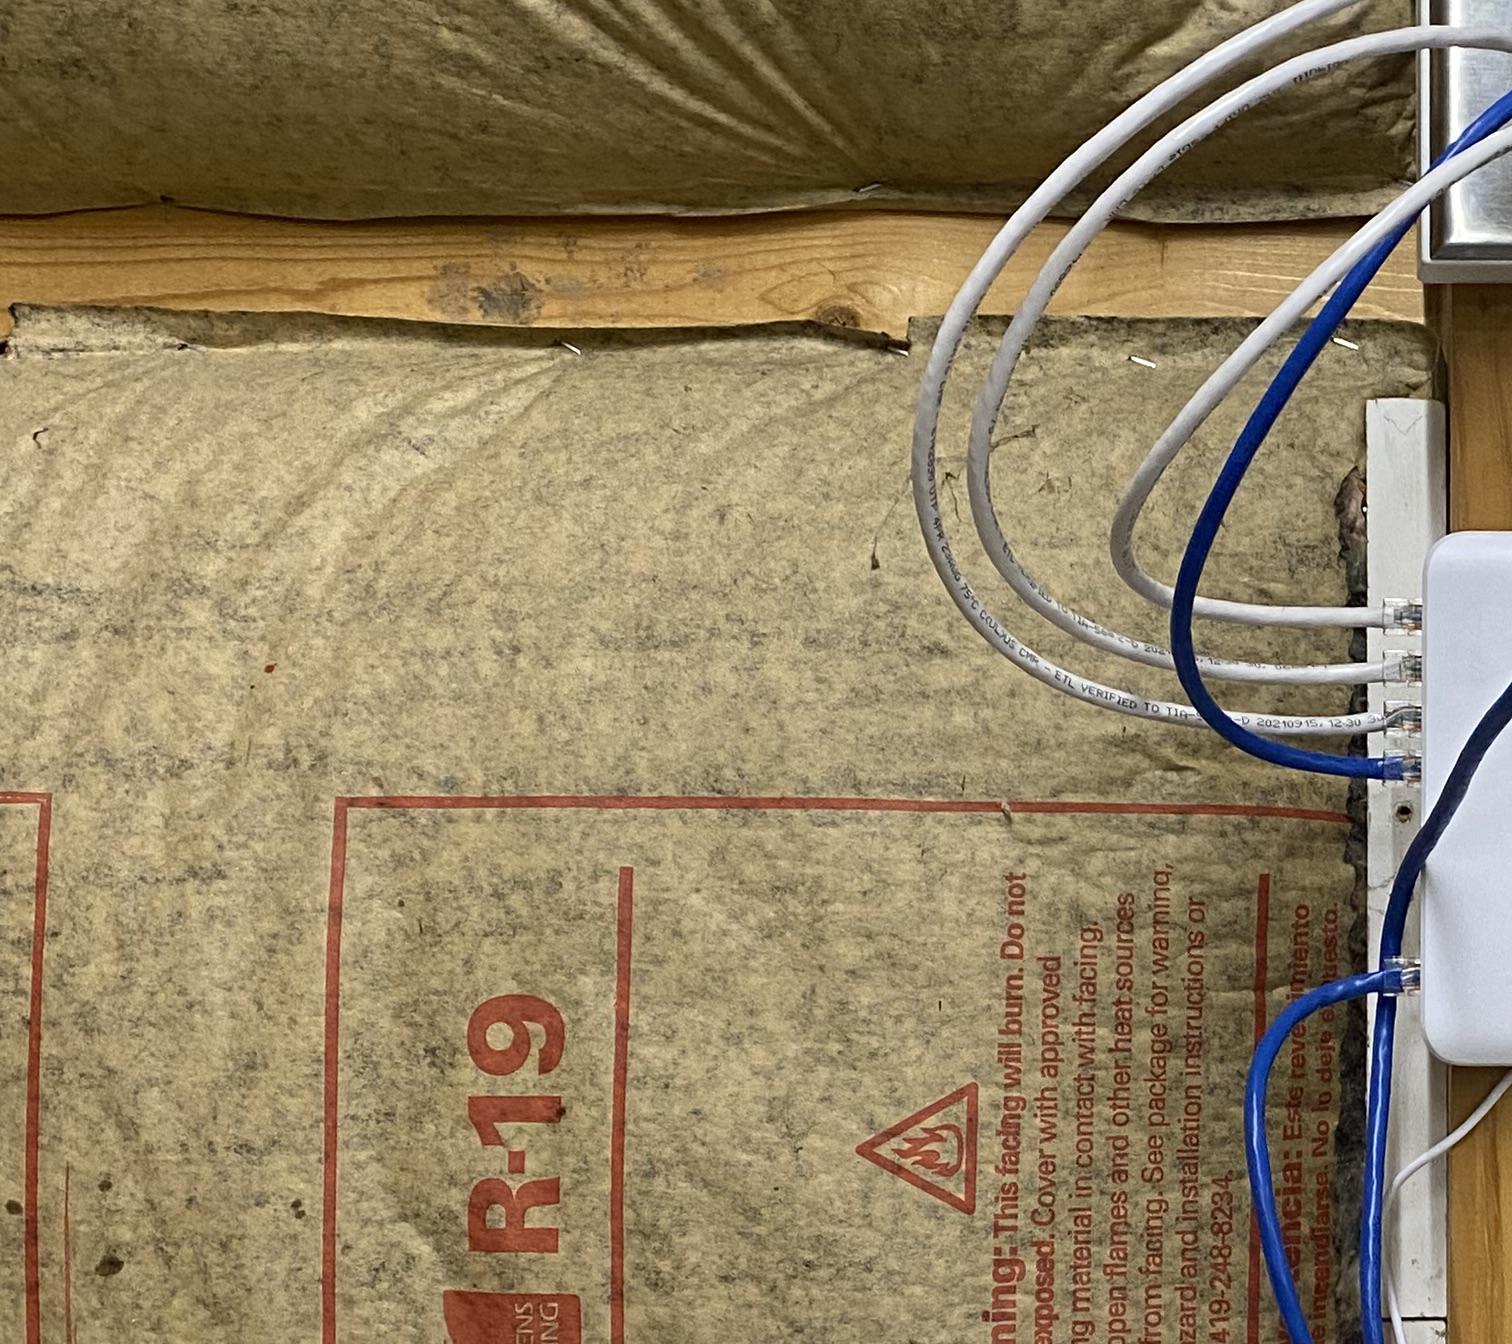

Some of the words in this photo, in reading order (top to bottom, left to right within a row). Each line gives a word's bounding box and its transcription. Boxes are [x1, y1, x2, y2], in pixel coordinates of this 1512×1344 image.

[1054, 670, 1075, 690] ETL
[1081, 684, 1138, 711] VERIFIED
[1144, 701, 1160, 714] TO
[1006, 874, 1026, 917] not
[1000, 923, 1025, 960] Do
[998, 970, 1024, 1037] burn.
[997, 1041, 1023, 1089] will
[468, 993, 566, 1254] R-19
[994, 1095, 1028, 1177] facing
[993, 1182, 1021, 1238] This
